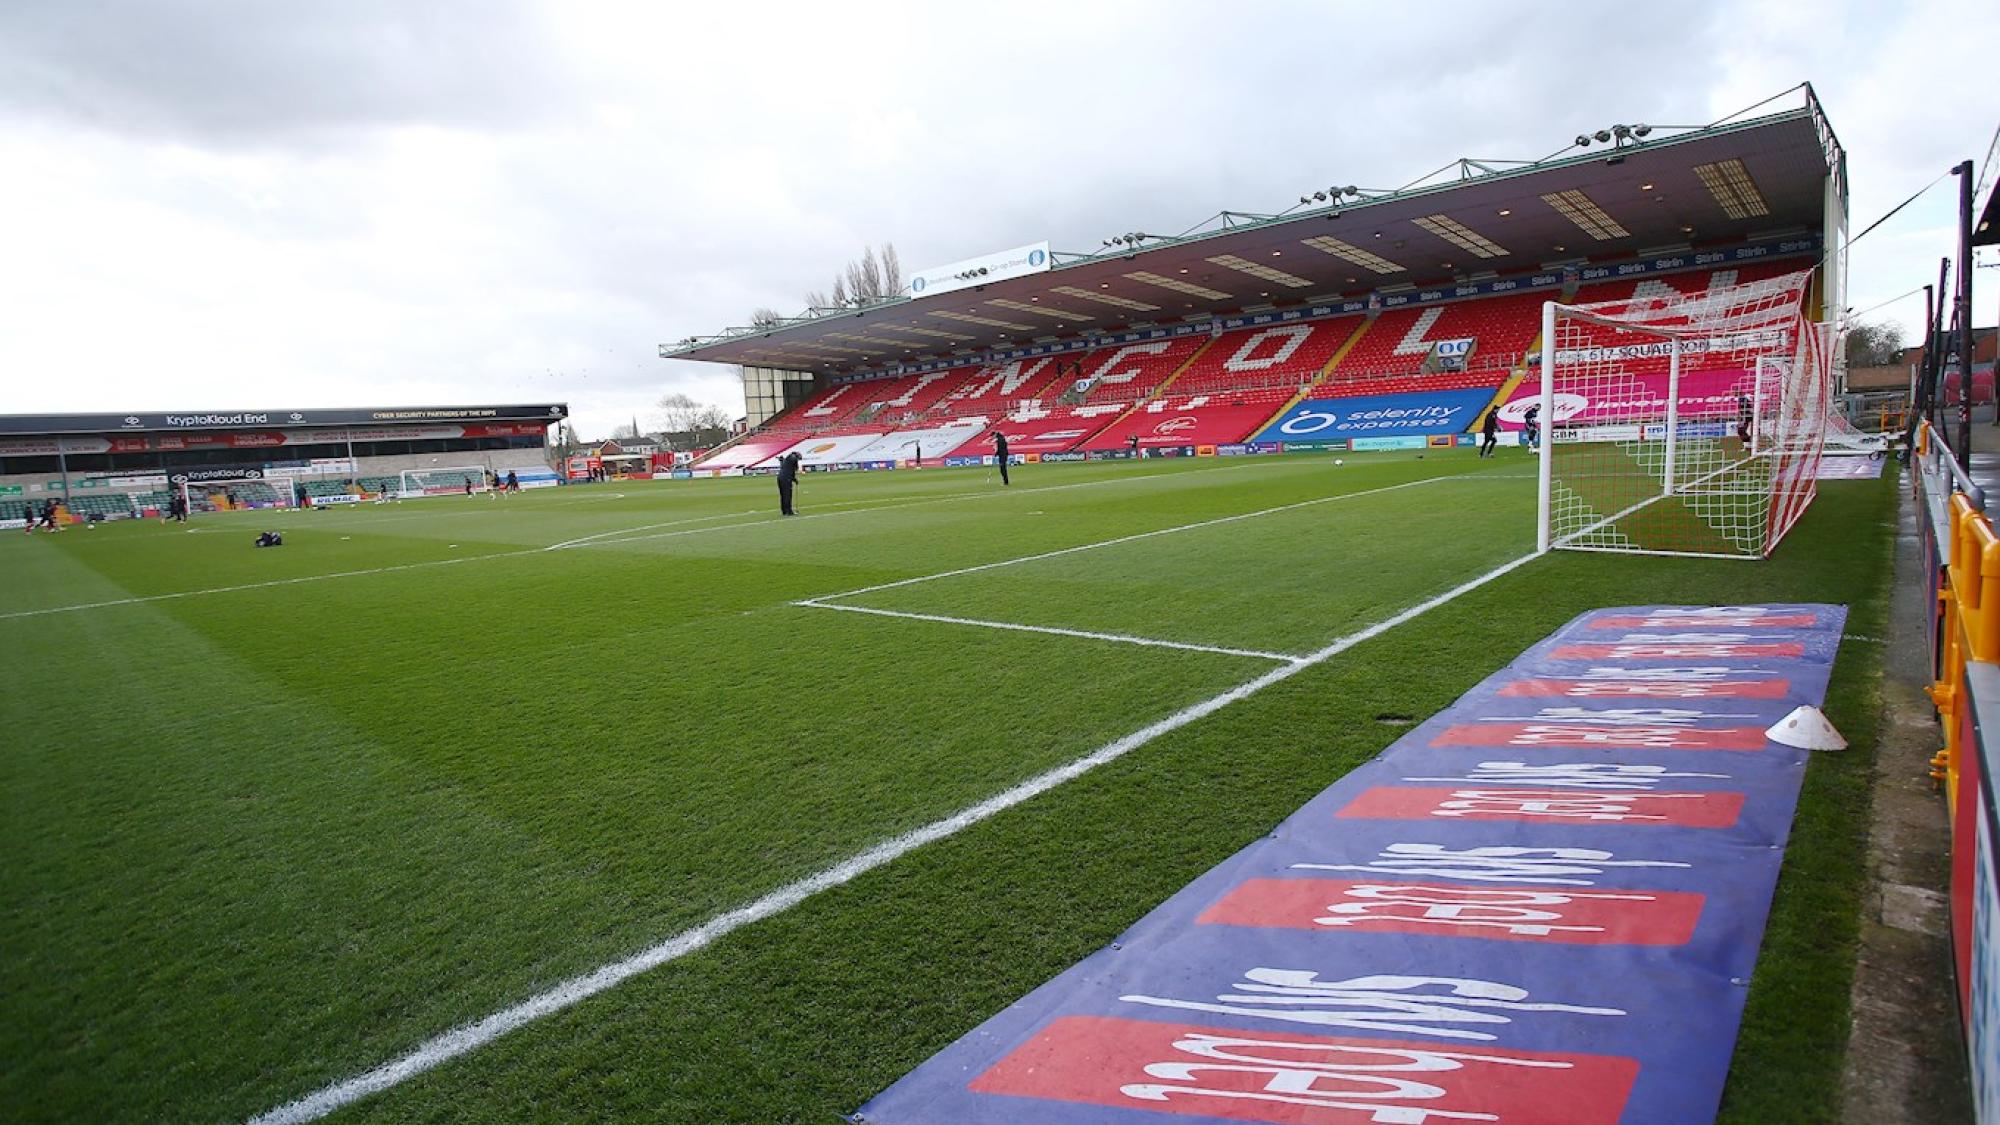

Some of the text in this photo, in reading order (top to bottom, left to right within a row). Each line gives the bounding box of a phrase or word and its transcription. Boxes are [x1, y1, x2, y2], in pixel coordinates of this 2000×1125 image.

[1695, 252, 1724, 264] Stirlin
[1736, 246, 1767, 259] Stirlin
[1618, 263, 1646, 275] Stirlin
[1655, 258, 1684, 269] Stirlin
[1583, 269, 1609, 279] Stirlin
[1492, 280, 1517, 291] Stirlin
[1531, 275, 1556, 286] Stirlin
[166, 413, 267, 426] KryptoKloud End
[1347, 406, 1462, 421] selenity
[1336, 418, 1450, 431] expenses
[188, 469, 245, 480] KryptoKloud
